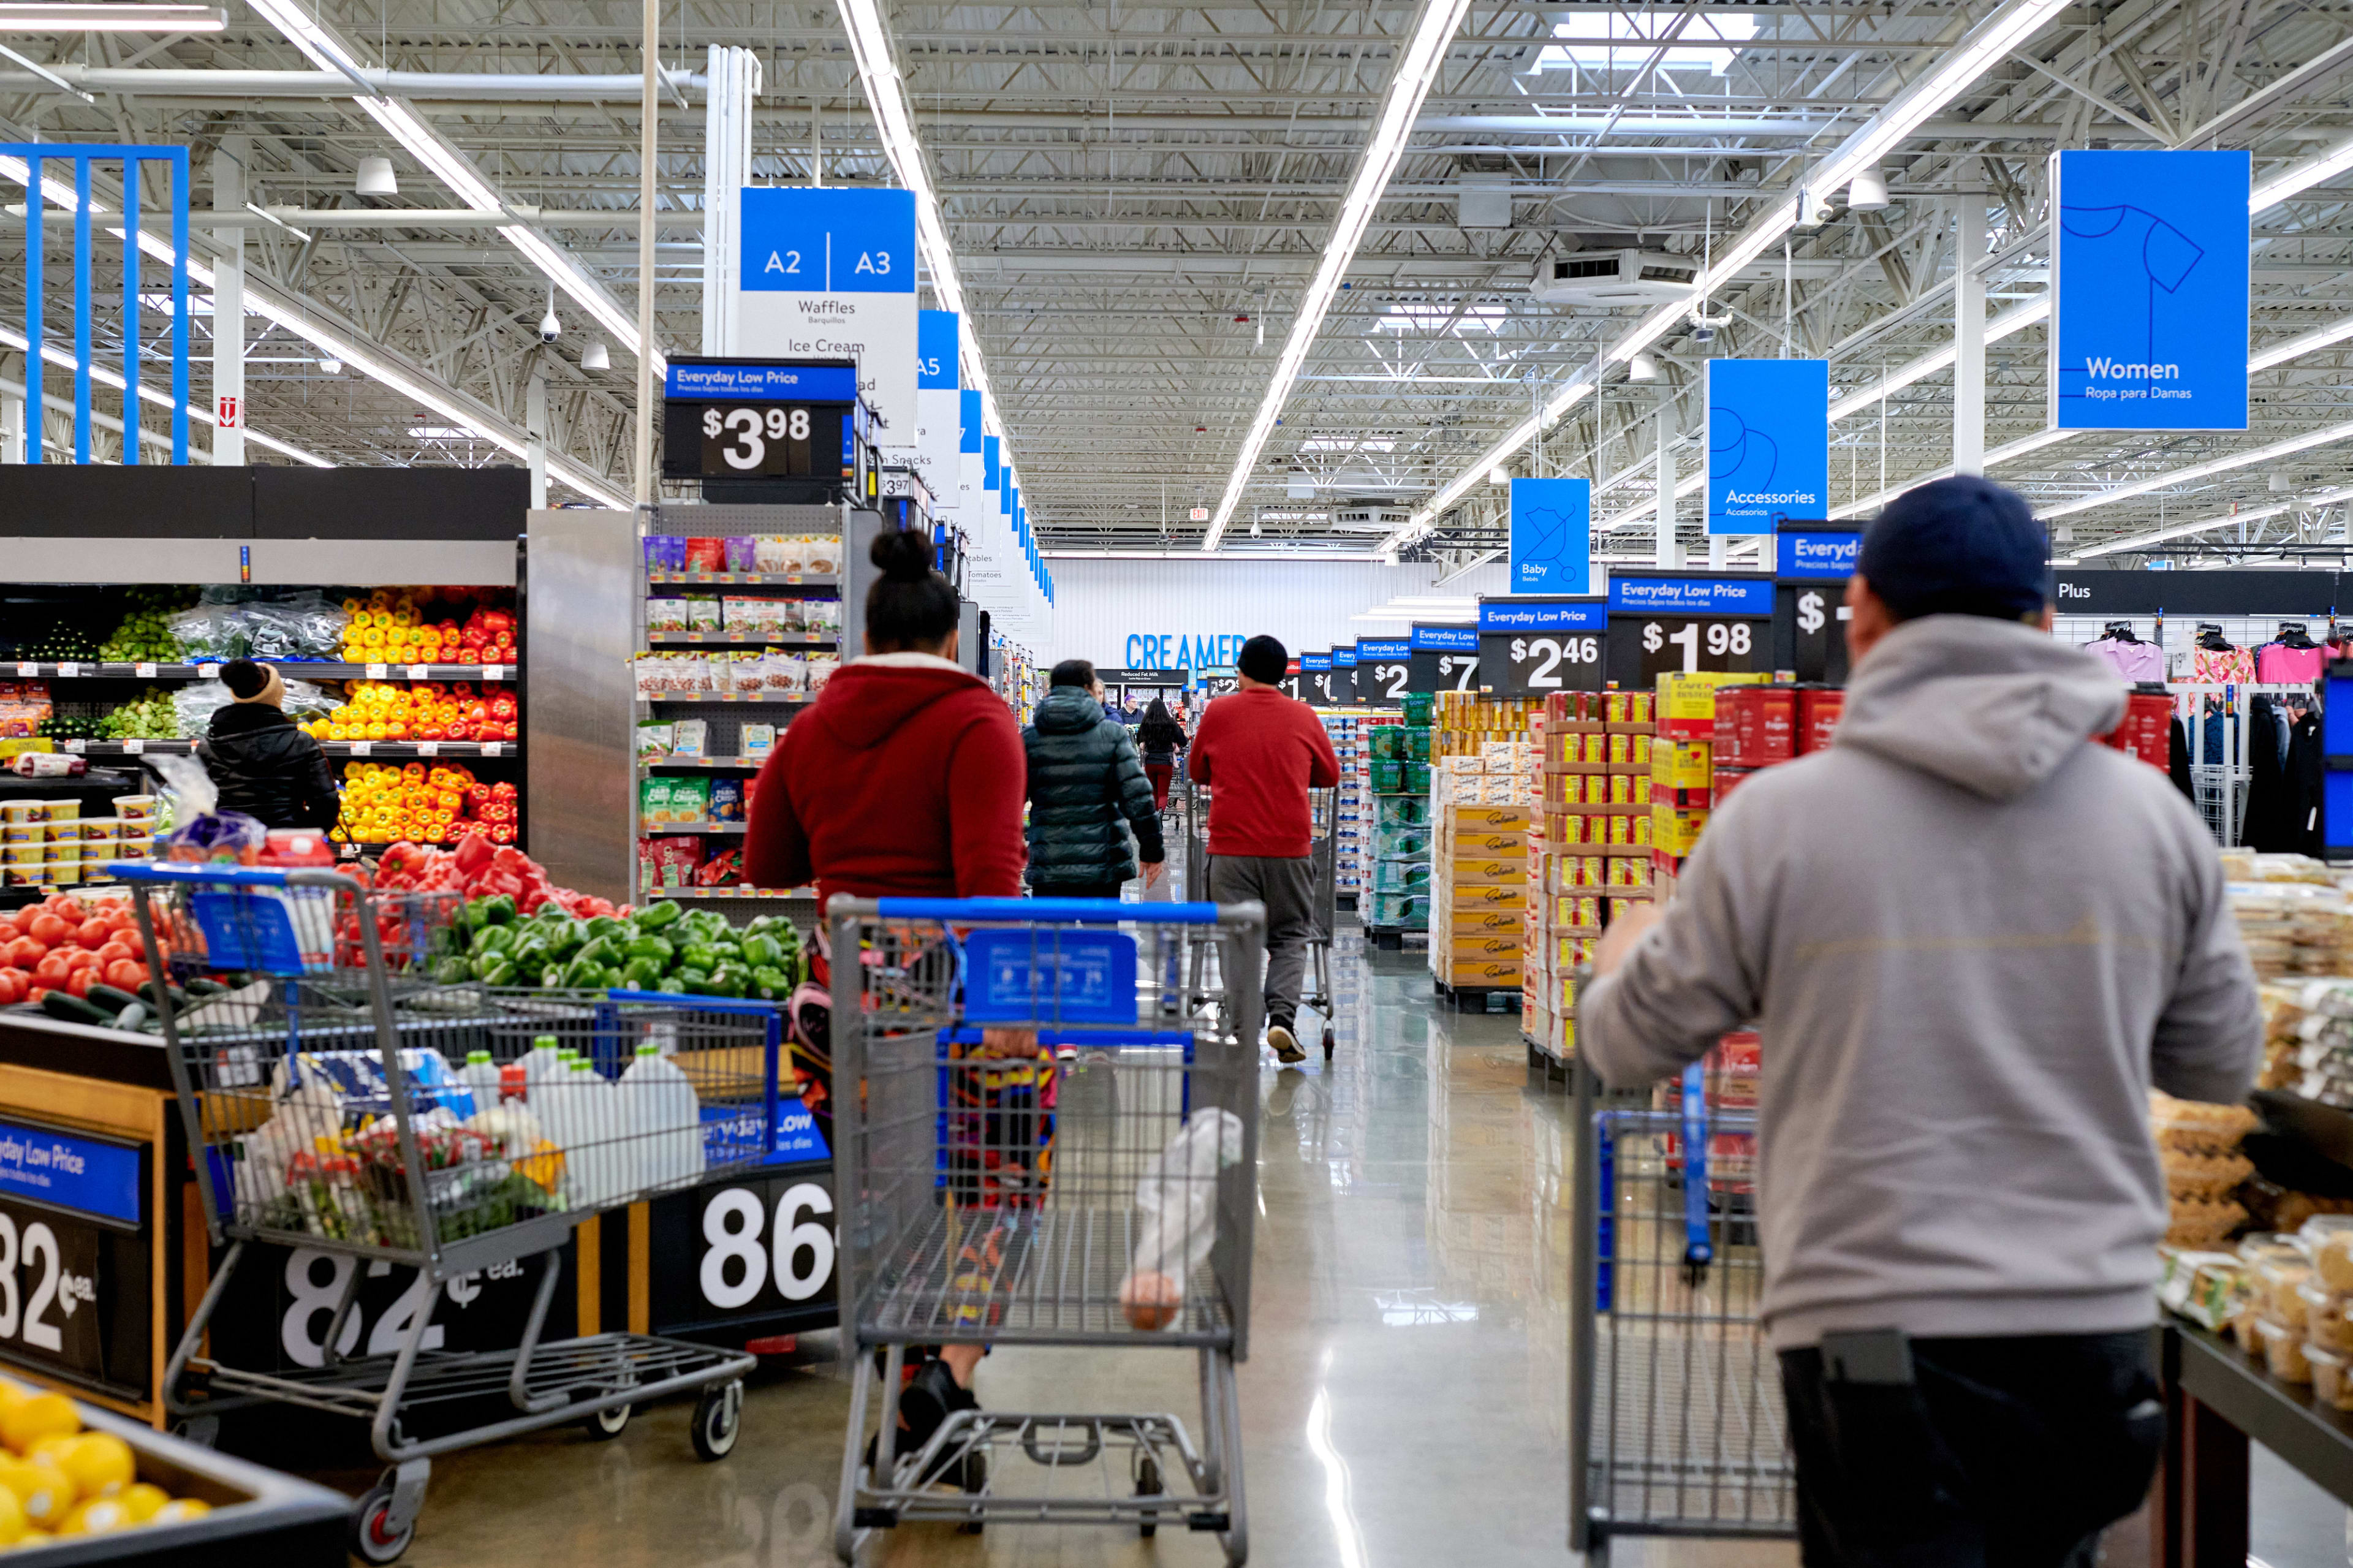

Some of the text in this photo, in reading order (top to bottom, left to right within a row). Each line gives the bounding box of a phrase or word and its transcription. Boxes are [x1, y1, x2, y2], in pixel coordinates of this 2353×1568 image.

[764, 250, 891, 275] A2 A3
[798, 300, 855, 314] Waffles
[808, 316, 846, 325] Barquillos
[789, 338, 865, 352] Ice Cream
[2085, 357, 2179, 379] Women
[676, 369, 799, 386] Everyday Low Price
[2085, 387, 2192, 401] Ropa para Damas
[892, 455, 931, 464] Snacks
[1726, 490, 1816, 505] Accessories
[1193, 509, 1205, 519] EXIT
[1795, 539, 1863, 561] Everyd
[1522, 564, 1548, 577] Baby
[1621, 583, 1747, 599] Everyday Low Price
[2058, 583, 2091, 599] Plus
[1488, 611, 1586, 624] Everyday Low Price
[1419, 630, 1457, 642] Everyday
[1363, 644, 1395, 653] Everyday
[26, 1139, 51, 1167] Low
[52, 1144, 85, 1175] Price
[700, 1183, 840, 1309] 86
